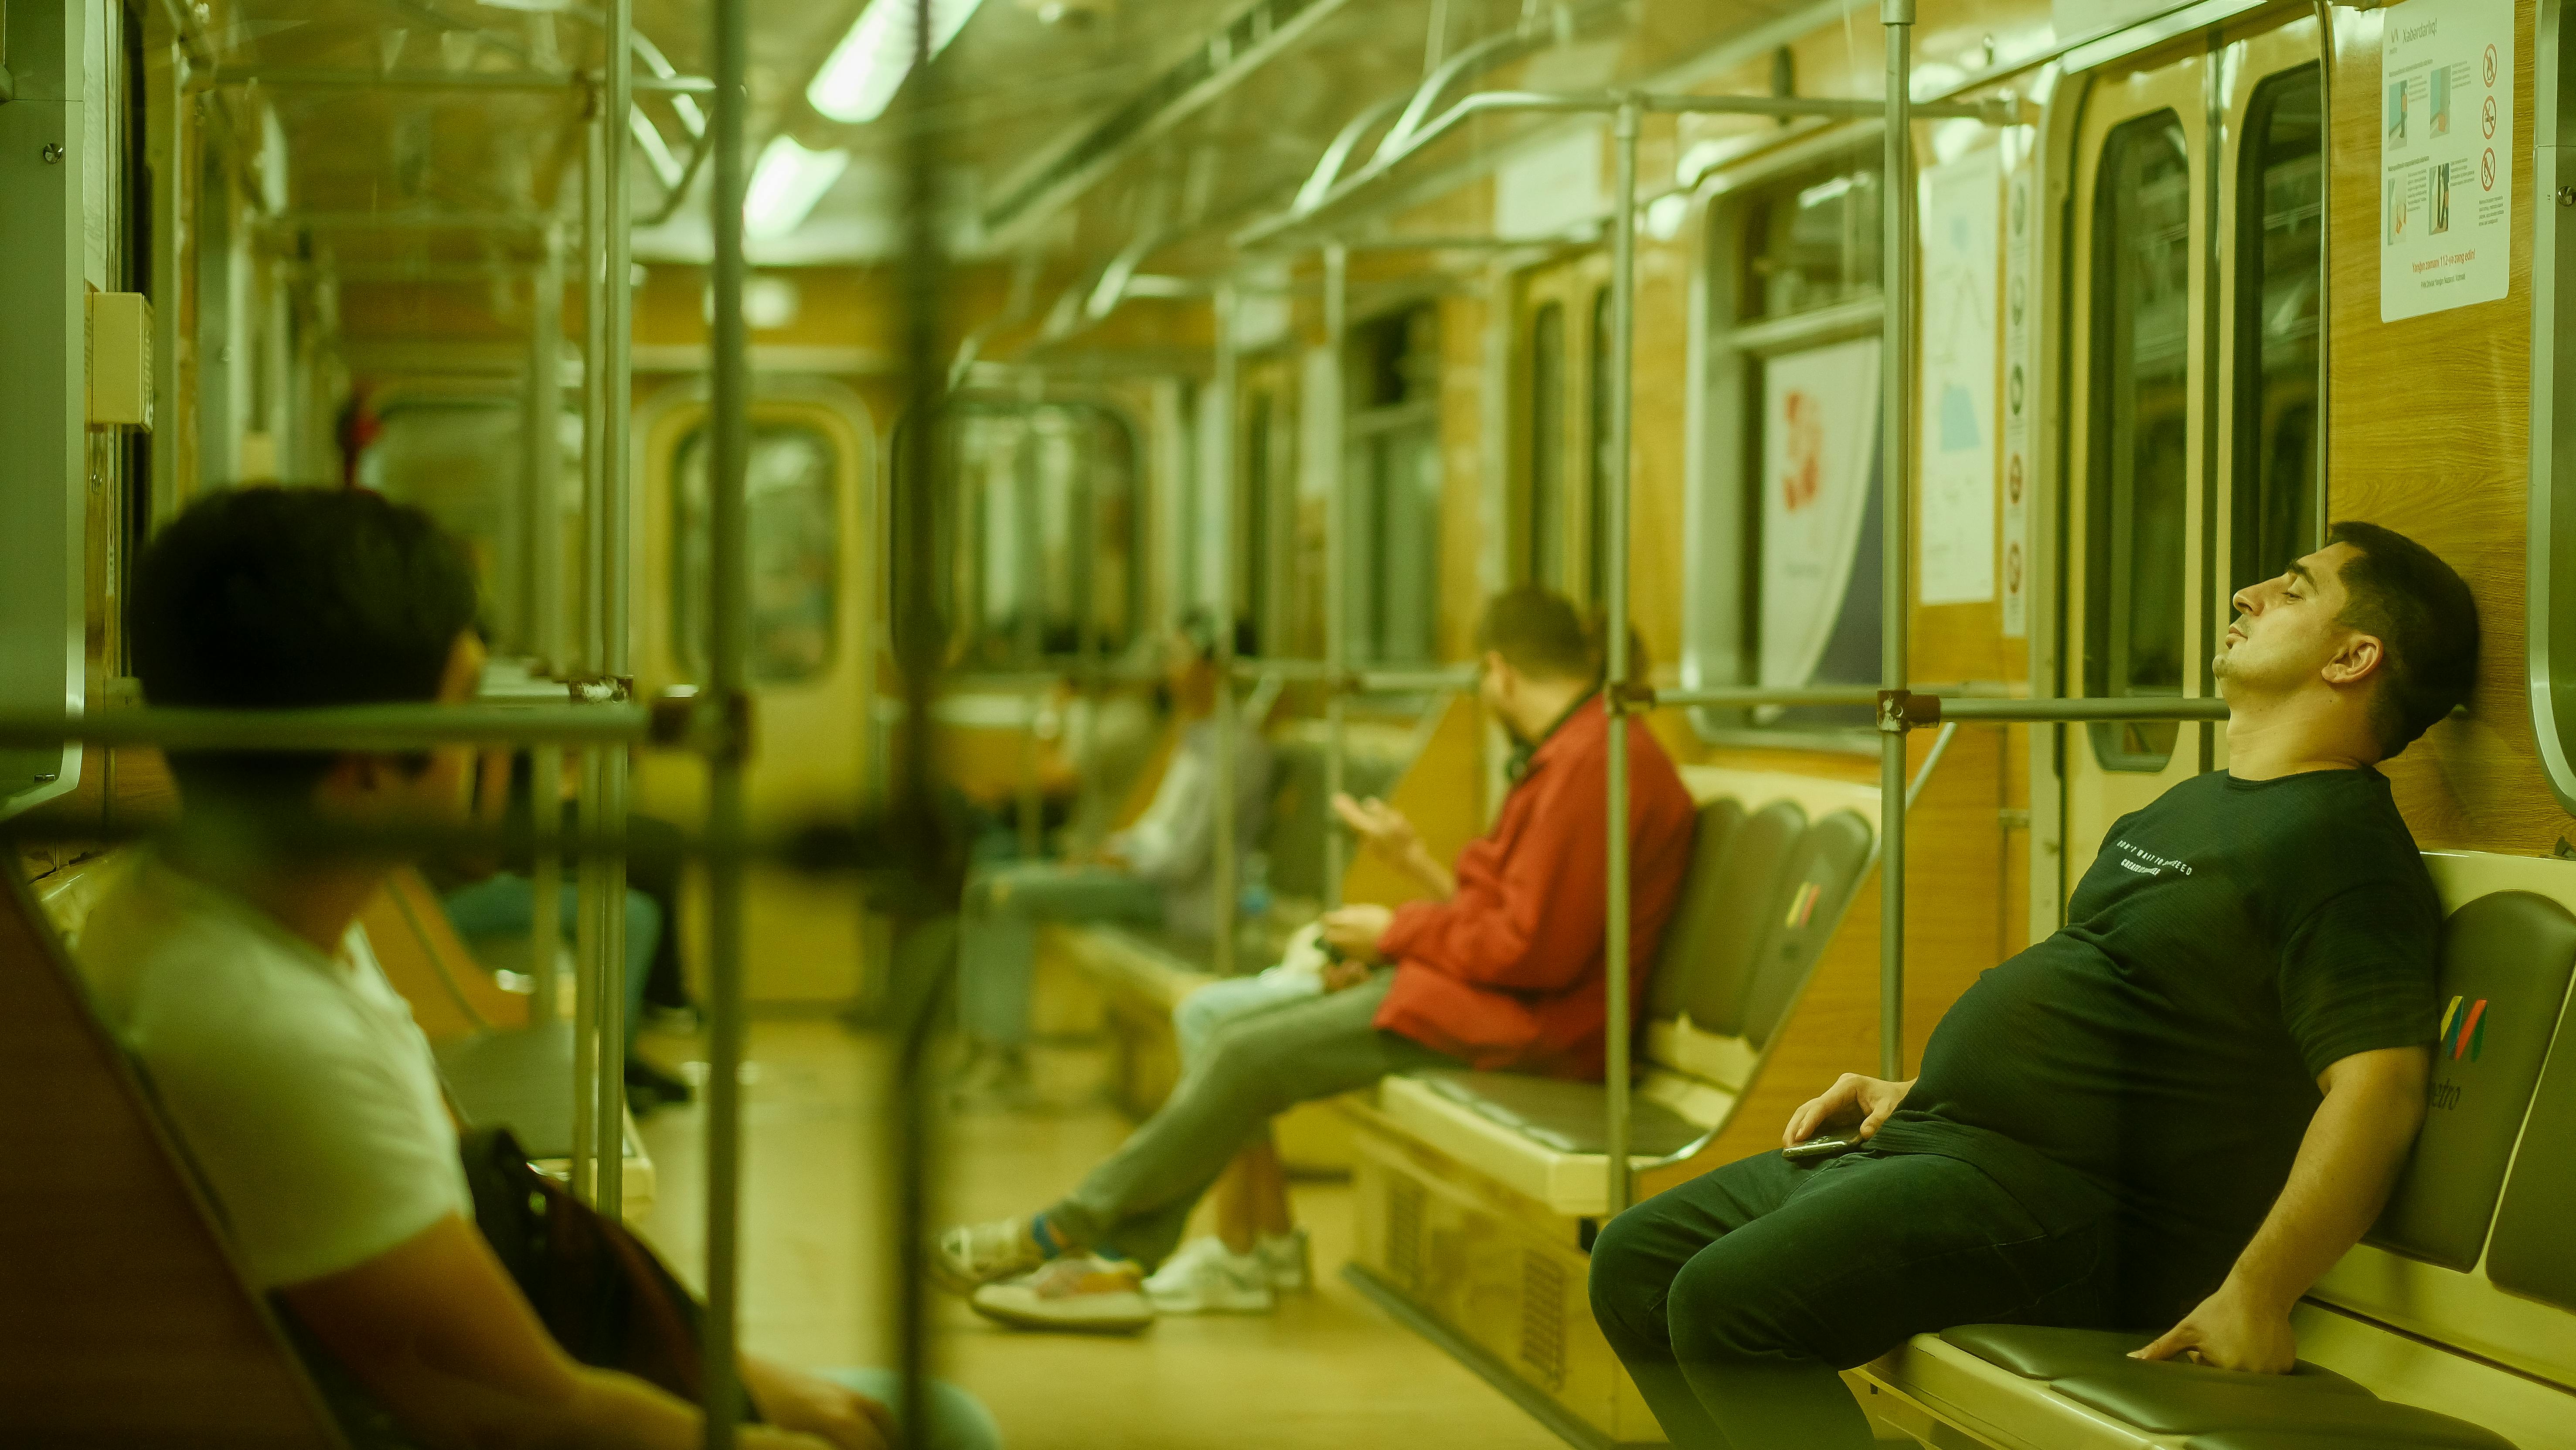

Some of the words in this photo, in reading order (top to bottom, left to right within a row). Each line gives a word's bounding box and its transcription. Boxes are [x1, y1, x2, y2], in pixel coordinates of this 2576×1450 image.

[2137, 849, 2156, 862] WAIT
[2154, 857, 2164, 865] TO
[2431, 1078, 2461, 1111] etro
